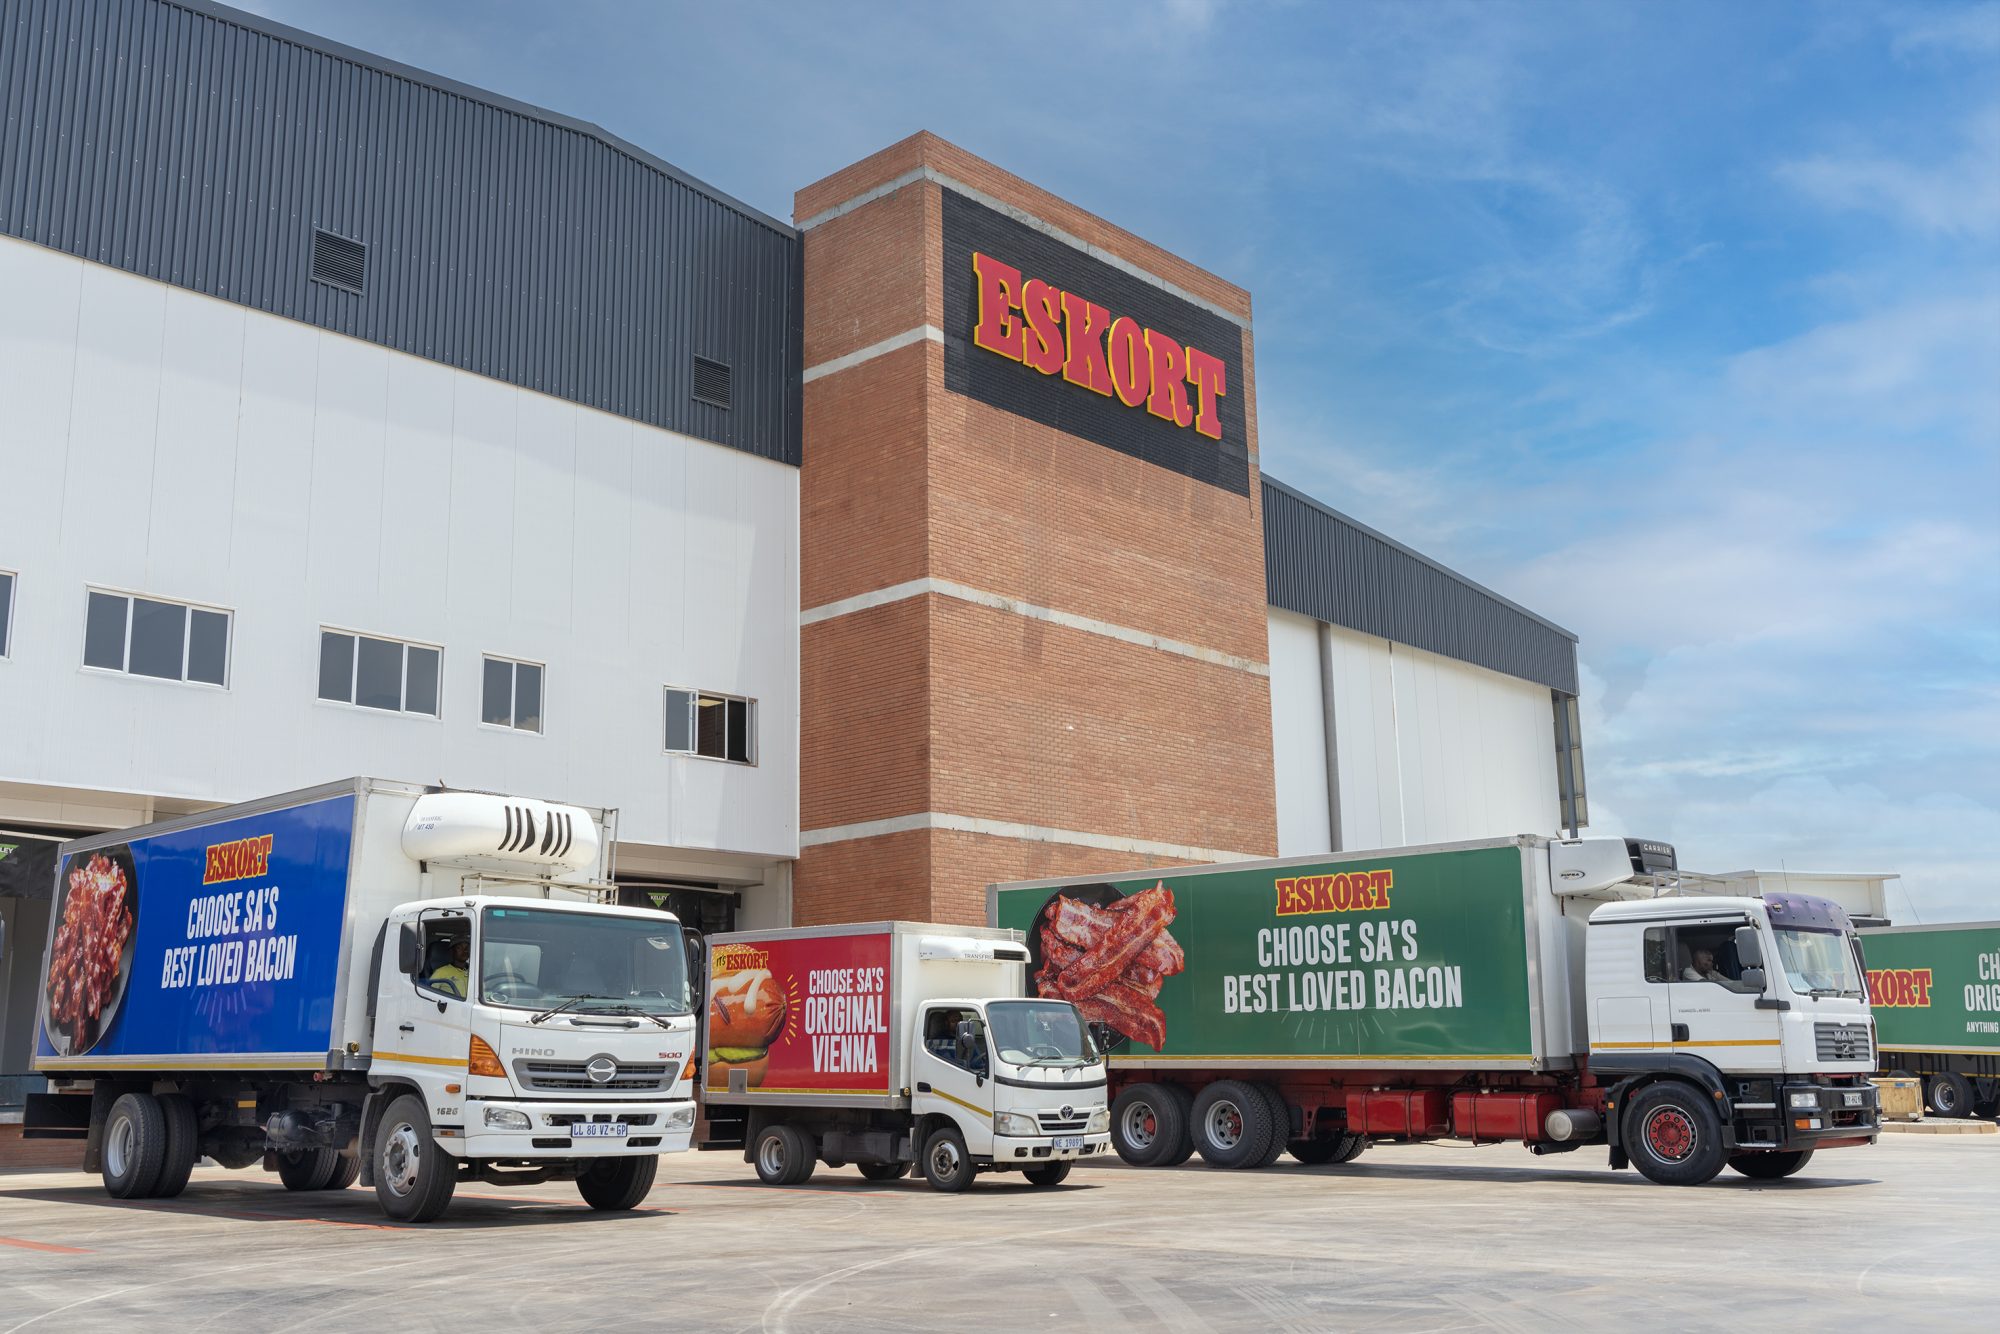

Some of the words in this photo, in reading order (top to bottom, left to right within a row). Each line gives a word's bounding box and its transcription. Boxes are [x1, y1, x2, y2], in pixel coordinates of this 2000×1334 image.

[973, 252, 1226, 439] ESKORT
[203, 833, 273, 885] ESKORT
[1643, 844, 1670, 854] CARRIER
[1275, 869, 1393, 917] ESKORT
[187, 892, 243, 939] CHOOSE
[243, 886, 279, 933] SA'S
[161, 945, 198, 989] BEST
[197, 941, 243, 986] LOVED
[245, 935, 297, 983] BACON
[716, 954, 726, 967] IT'S
[726, 951, 769, 971] ESKORT
[1257, 923, 1351, 967] CHOOSE
[1359, 919, 1418, 962] SA'S
[809, 969, 853, 995] CHOOSE
[857, 967, 884, 993] SA'S
[1223, 973, 1280, 1014] BEST
[1288, 970, 1366, 1012] LOVED
[1374, 965, 1463, 1010] BACON
[1866, 968, 1933, 1008] KORT
[1963, 984, 2000, 1012] ORIG
[805, 995, 887, 1034] ORIGINAL
[1966, 1021, 1999, 1033] ANYTHING
[512, 1048, 555, 1057] HINO
[812, 1035, 878, 1073] VIENNA
[1834, 1031, 1855, 1041] MAN
[573, 1125, 585, 1136] LL
[586, 1125, 597, 1136] 80
[599, 1125, 609, 1136] VZ
[616, 1125, 627, 1136] GP
